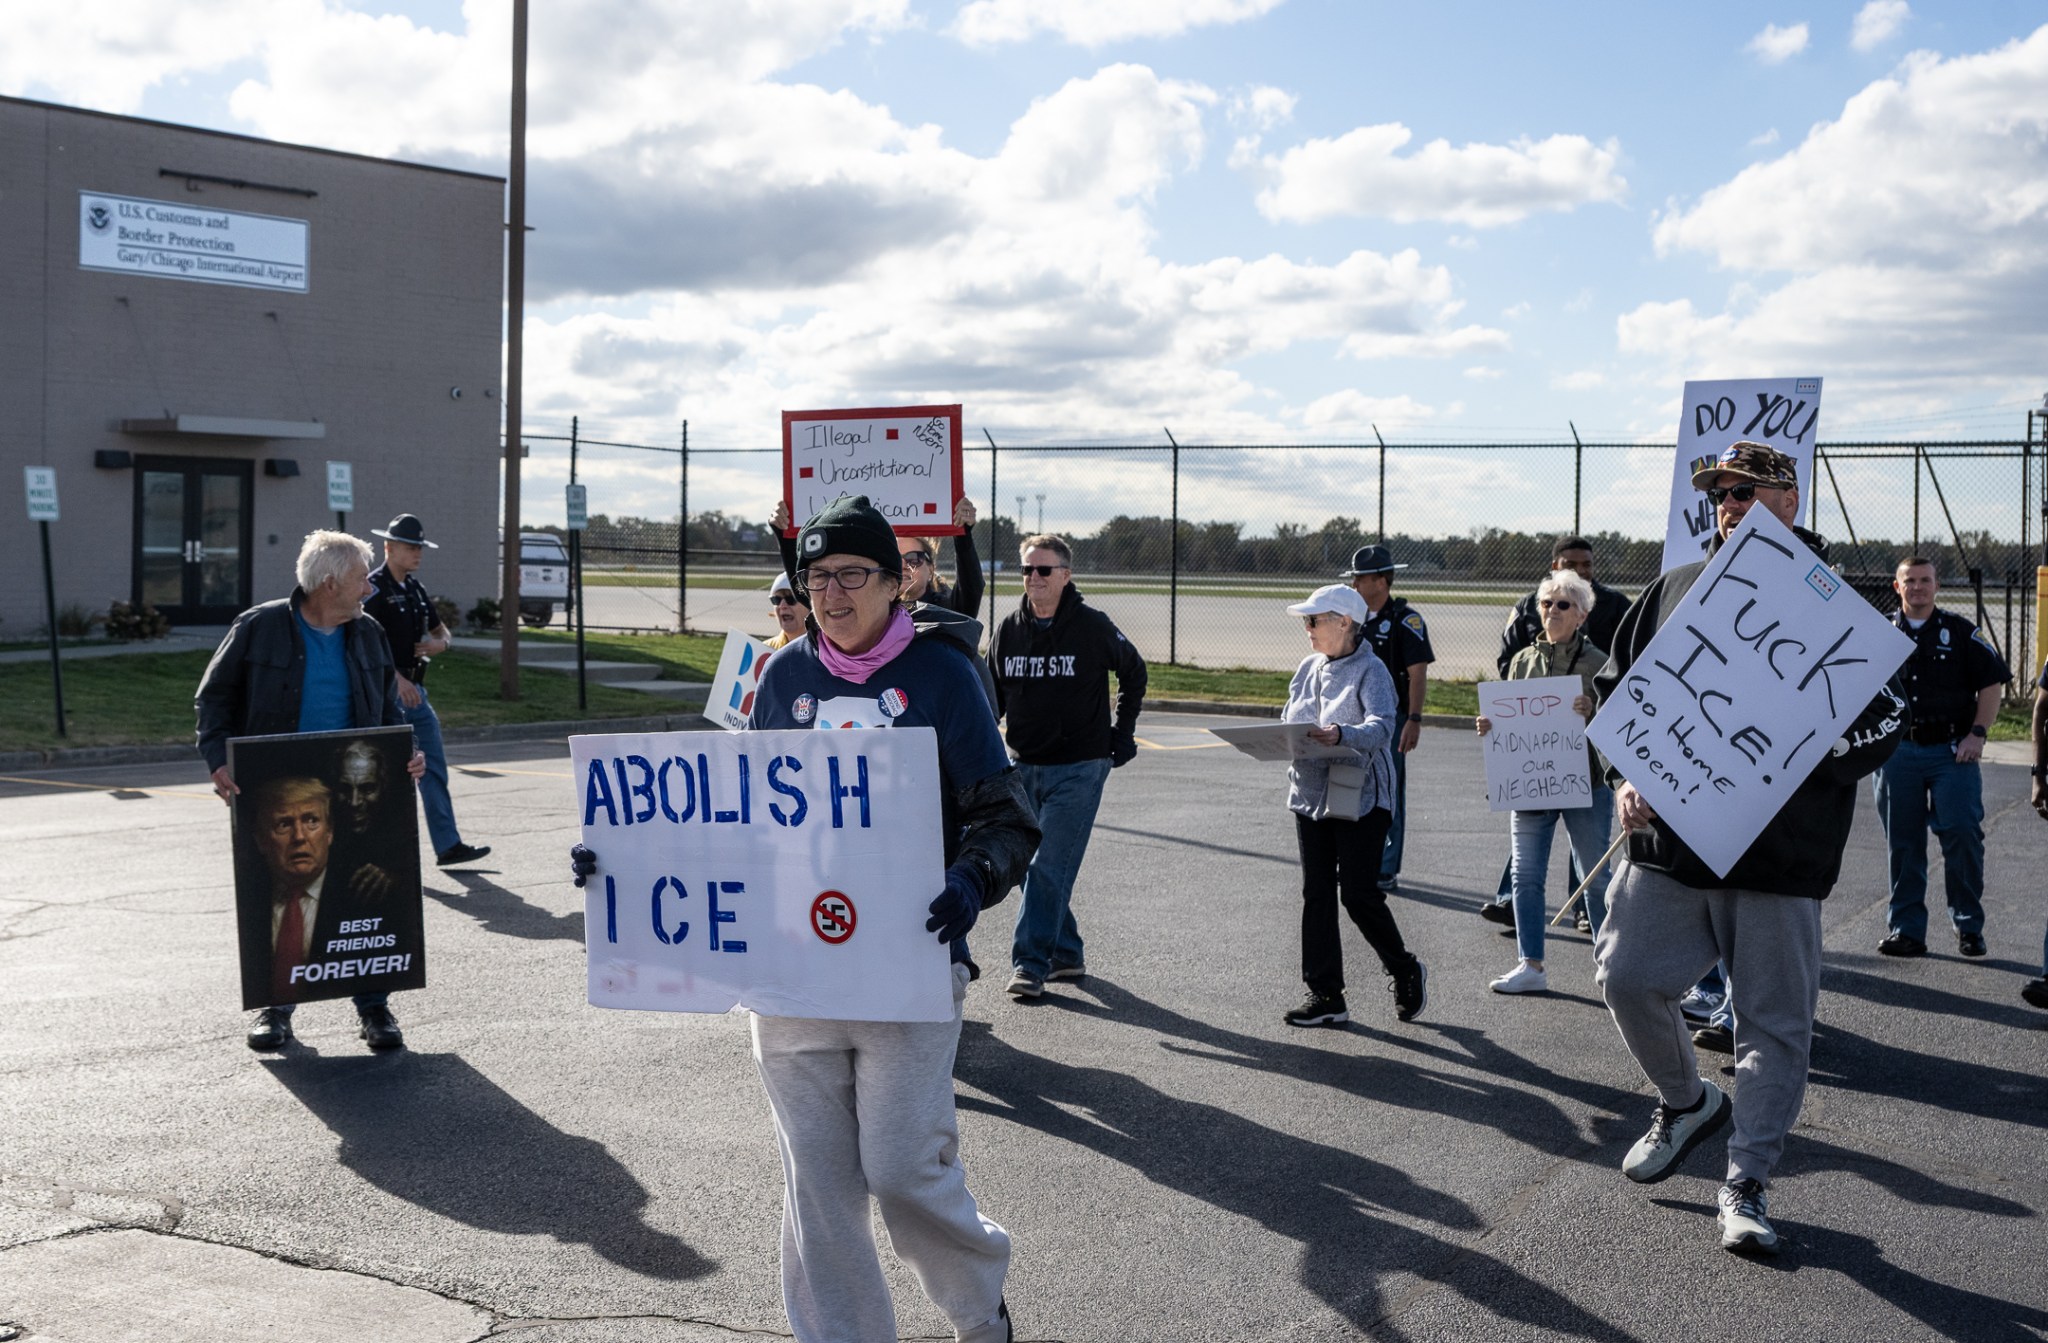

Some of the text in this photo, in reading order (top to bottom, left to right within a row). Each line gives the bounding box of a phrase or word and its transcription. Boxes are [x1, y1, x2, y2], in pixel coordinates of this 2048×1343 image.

[118, 203, 230, 230] U.S. Customs and
[118, 226, 235, 252] Border Protection
[196, 257, 264, 277] International
[266, 266, 304, 284] Airport
[1695, 393, 1819, 445] DO YOU
[803, 424, 872, 457] Illegal
[912, 425, 945, 455] Noem
[819, 453, 934, 485] Unconstitutional
[1700, 528, 1868, 719] FUCK
[799, 709, 810, 717] NO
[1492, 695, 1561, 718] STOP
[1654, 625, 1816, 785] ICE!
[723, 711, 748, 730] INDIV
[1490, 729, 1583, 754] KIDNAPPING
[1522, 760, 1556, 774] OUR
[584, 752, 871, 828] ABOLISH
[1497, 774, 1591, 803] NEIGHBORS
[339, 917, 383, 934] BEST
[605, 875, 747, 953] ICE
[326, 934, 396, 953] FRIENDS
[289, 953, 412, 984] FOREVER!
